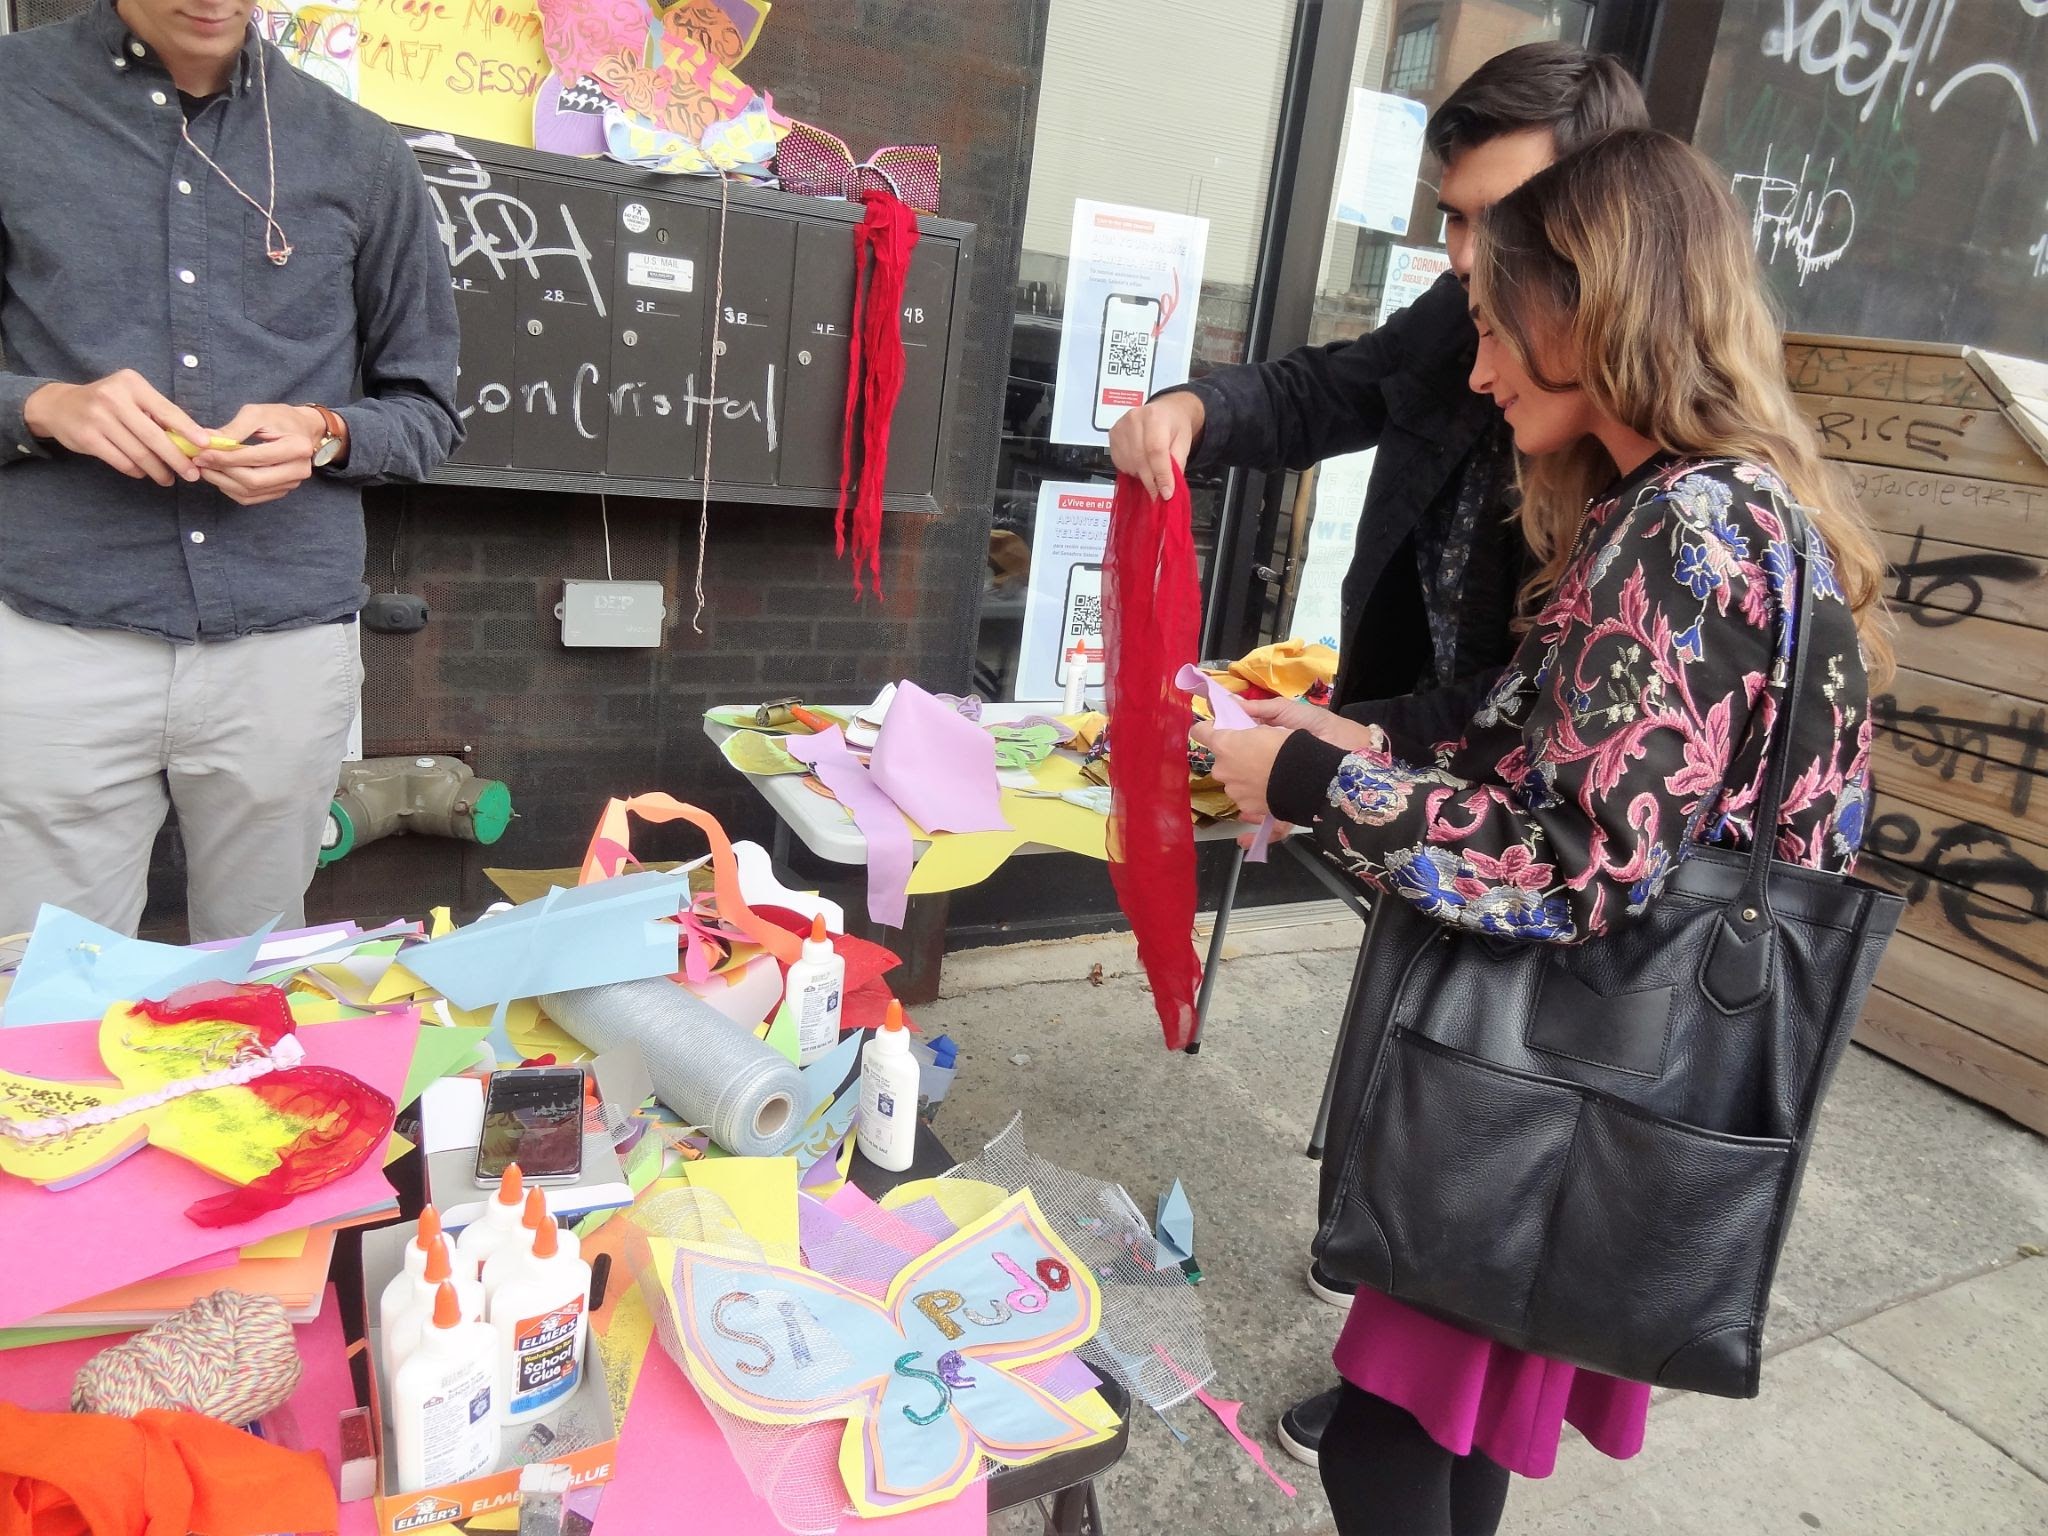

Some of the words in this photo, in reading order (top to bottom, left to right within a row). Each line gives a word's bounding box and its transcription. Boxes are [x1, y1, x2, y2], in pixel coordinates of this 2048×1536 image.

[543, 289, 565, 303] 2B
[635, 300, 656, 313] 3F
[724, 307, 748, 325] 3B
[903, 307, 925, 325] 4B
[816, 323, 835, 335] 4F
[1815, 411, 1965, 462] RICE
[1062, 498, 1084, 508] ¿Vive
[1097, 501, 1105, 509] el
[522, 1319, 577, 1350] ELMER'S
[524, 1344, 572, 1375] School
[529, 1366, 562, 1385] Glue
[397, 1508, 460, 1531] ELMER'S
